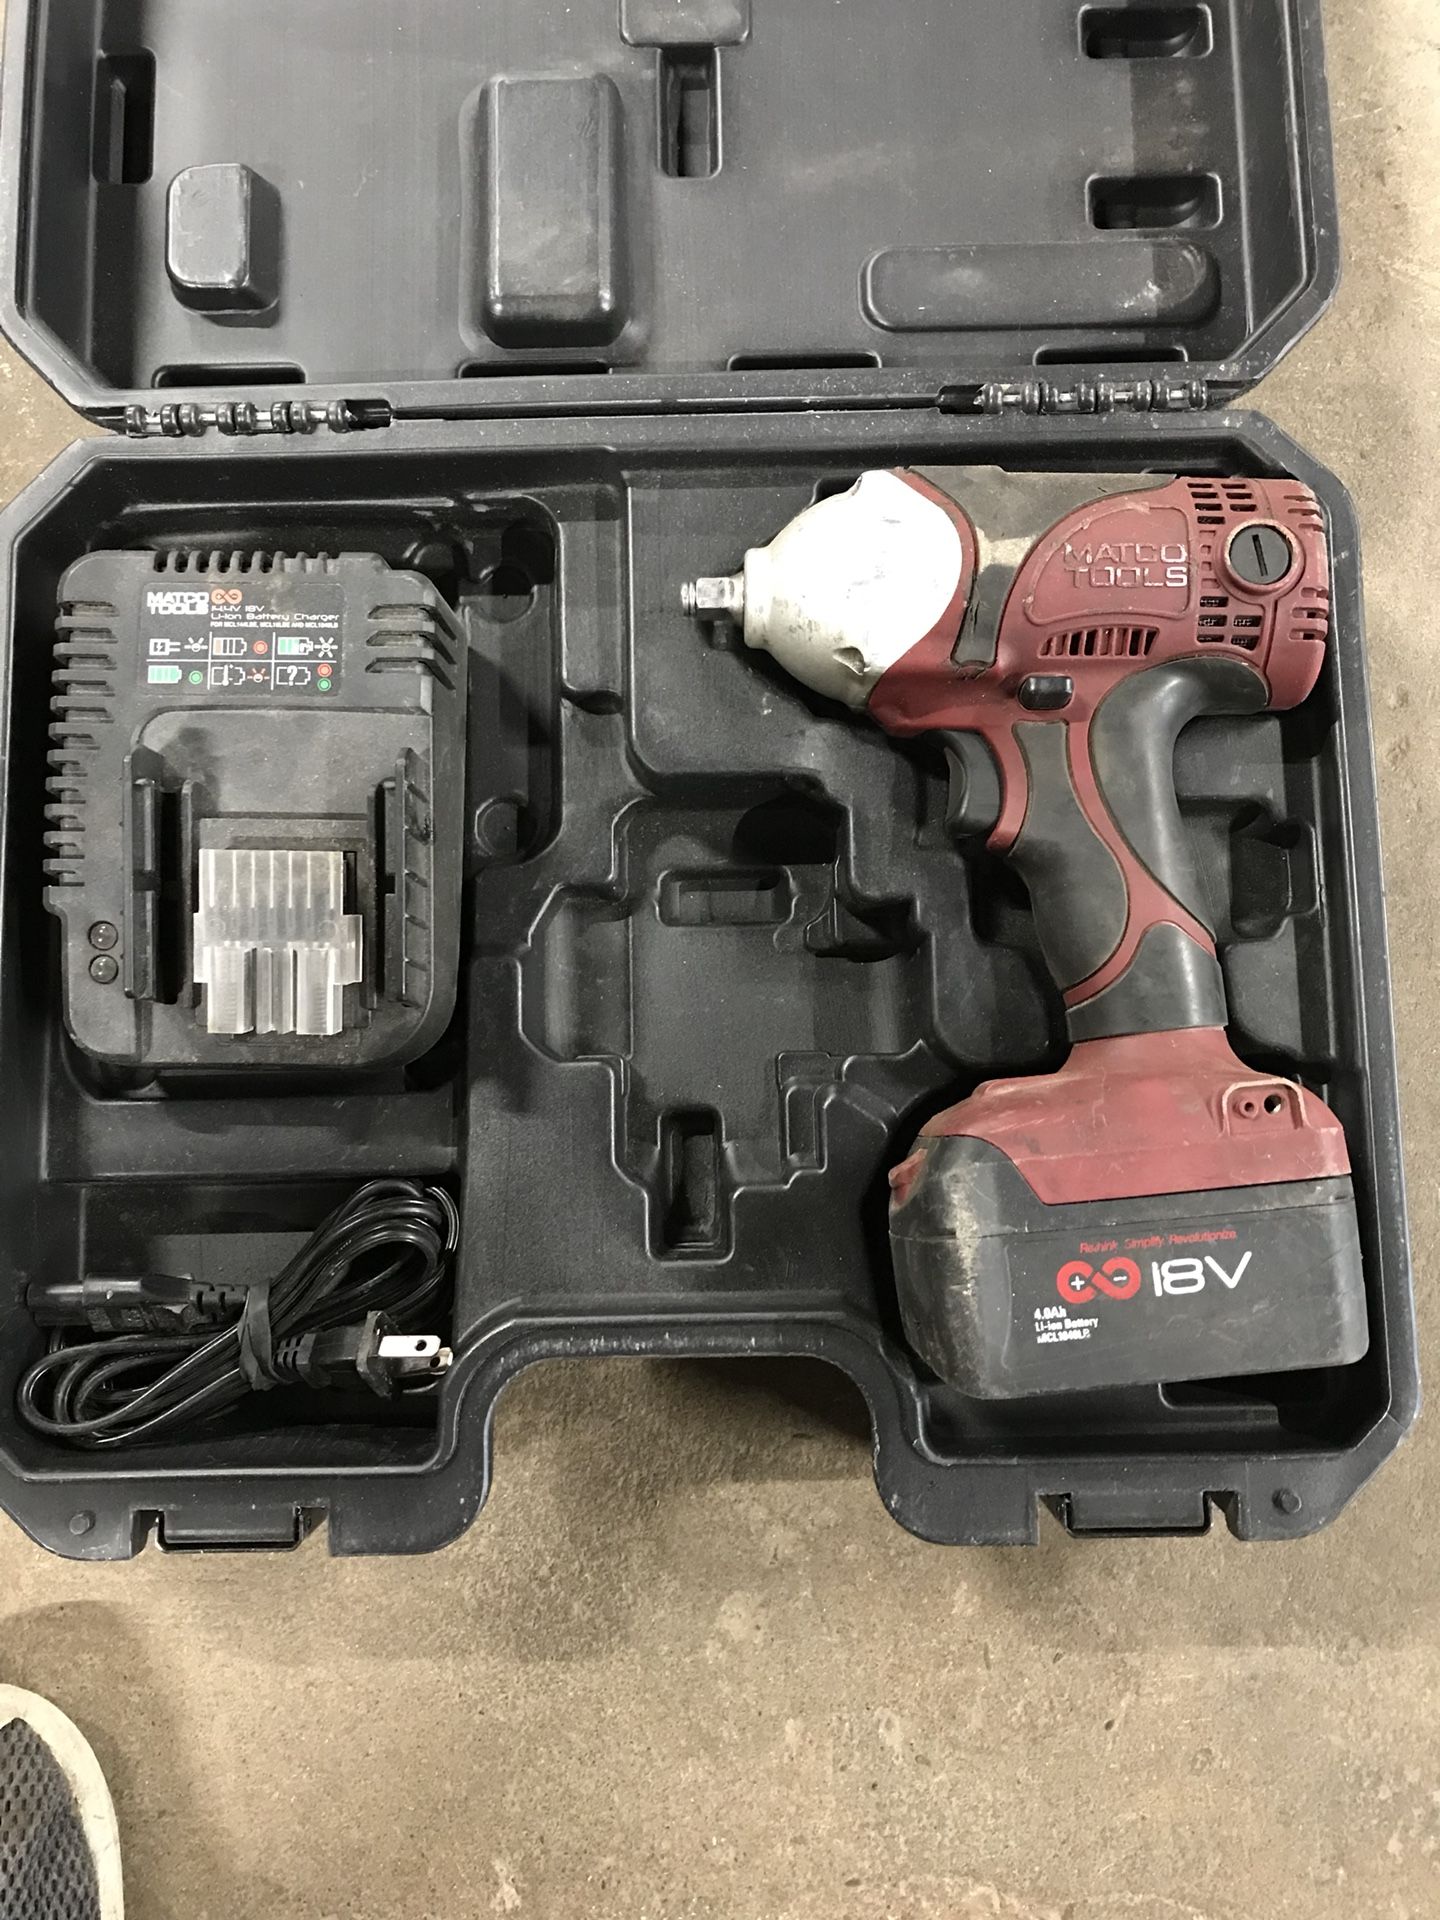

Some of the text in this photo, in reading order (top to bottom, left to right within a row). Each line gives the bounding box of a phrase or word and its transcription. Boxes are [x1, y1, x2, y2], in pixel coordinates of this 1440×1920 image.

[1064, 542, 1188, 564] MATCO
[1064, 566, 1188, 587] TOOLS
[147, 592, 209, 605] MATCO
[149, 603, 209, 615] TOOLS
[246, 613, 290, 621] Battery
[294, 613, 340, 621] Charger
[1151, 1251, 1252, 1297] 18V
[1064, 1318, 1099, 1329] Battery
